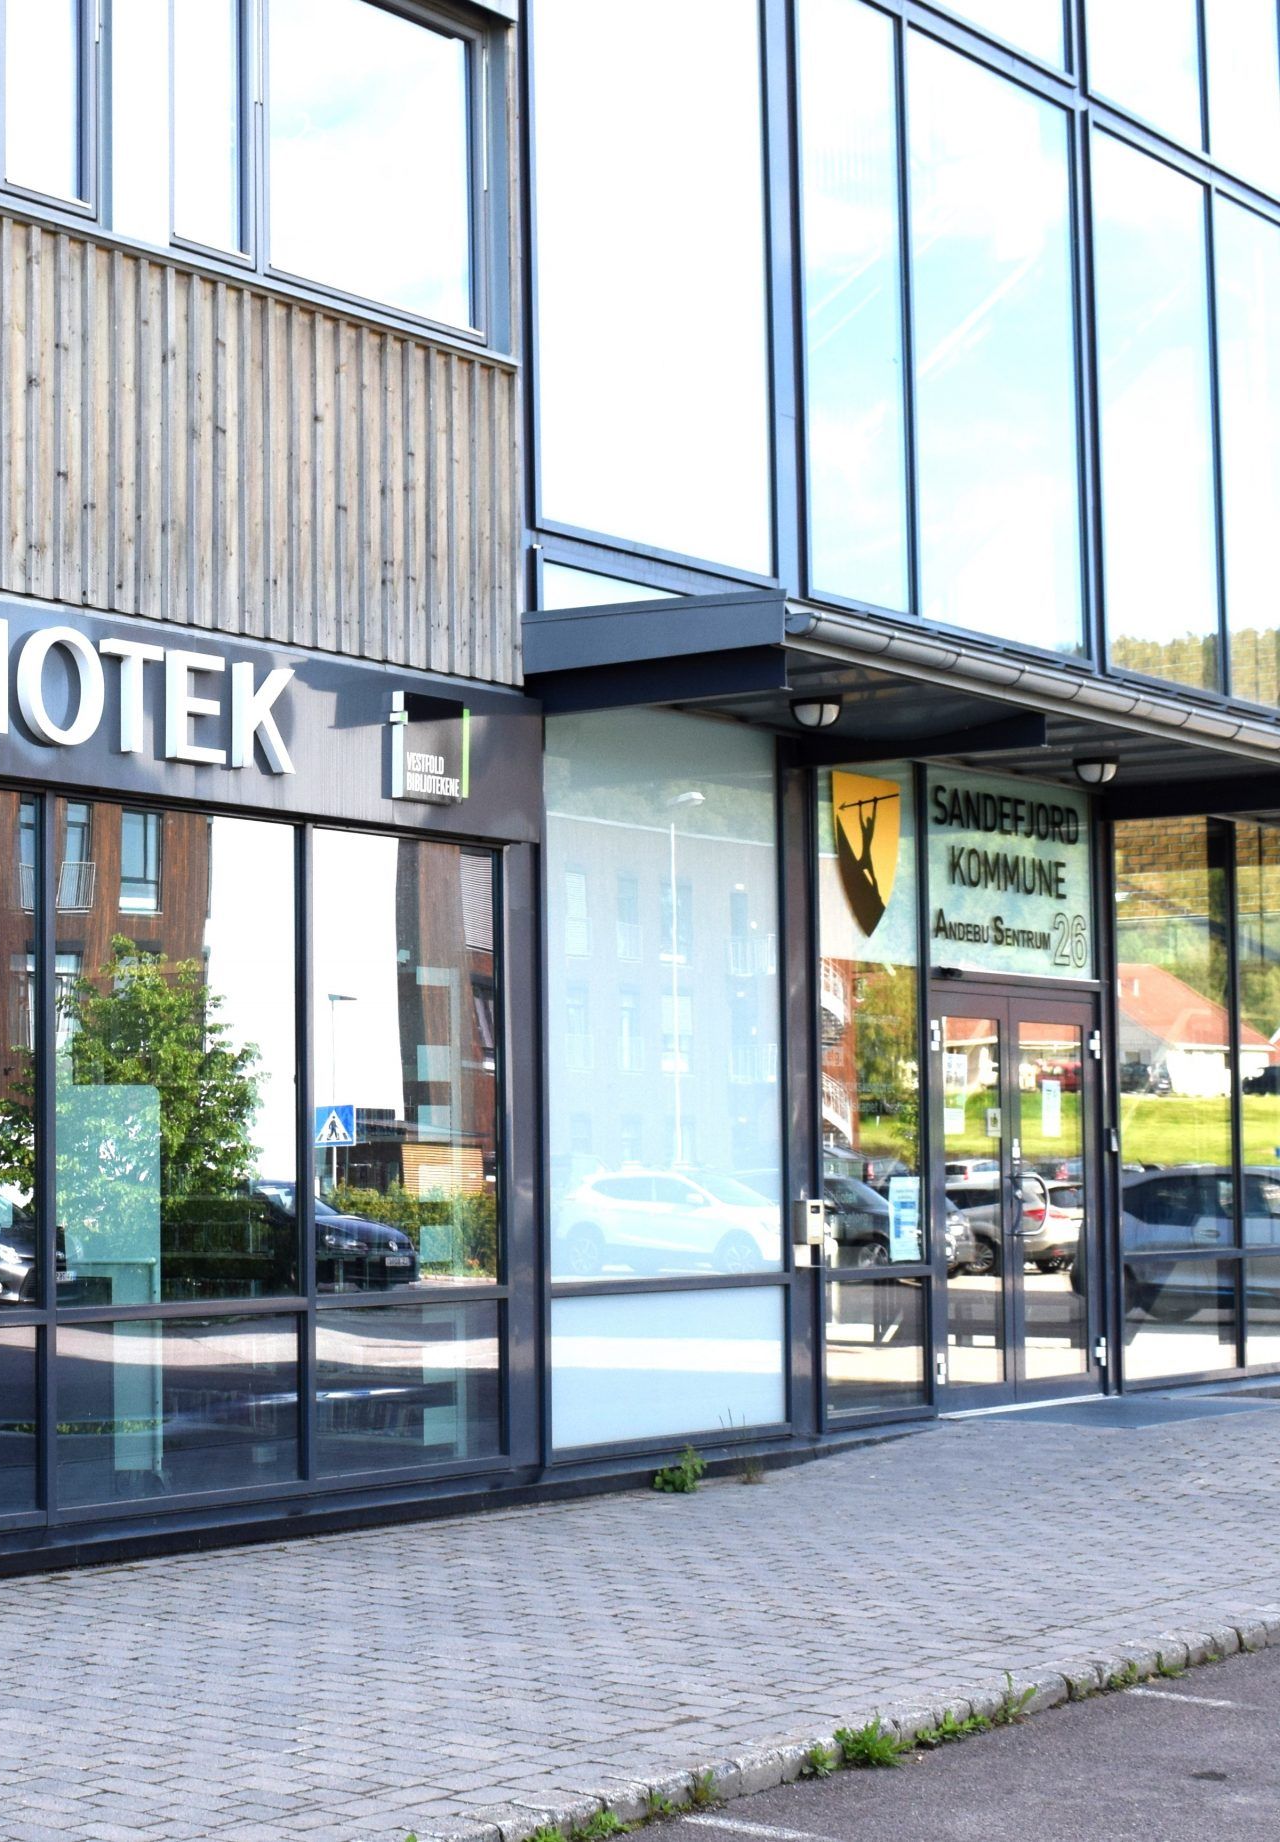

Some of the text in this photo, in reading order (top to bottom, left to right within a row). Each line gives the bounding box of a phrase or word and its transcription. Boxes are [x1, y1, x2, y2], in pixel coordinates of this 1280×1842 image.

[407, 751, 445, 775] VESTFOLD
[407, 771, 460, 797] BIBLIOTEKENE
[933, 784, 1079, 845] SANDEFJORD
[950, 845, 1067, 899] KOMMUNE
[1053, 911, 1088, 968] 26
